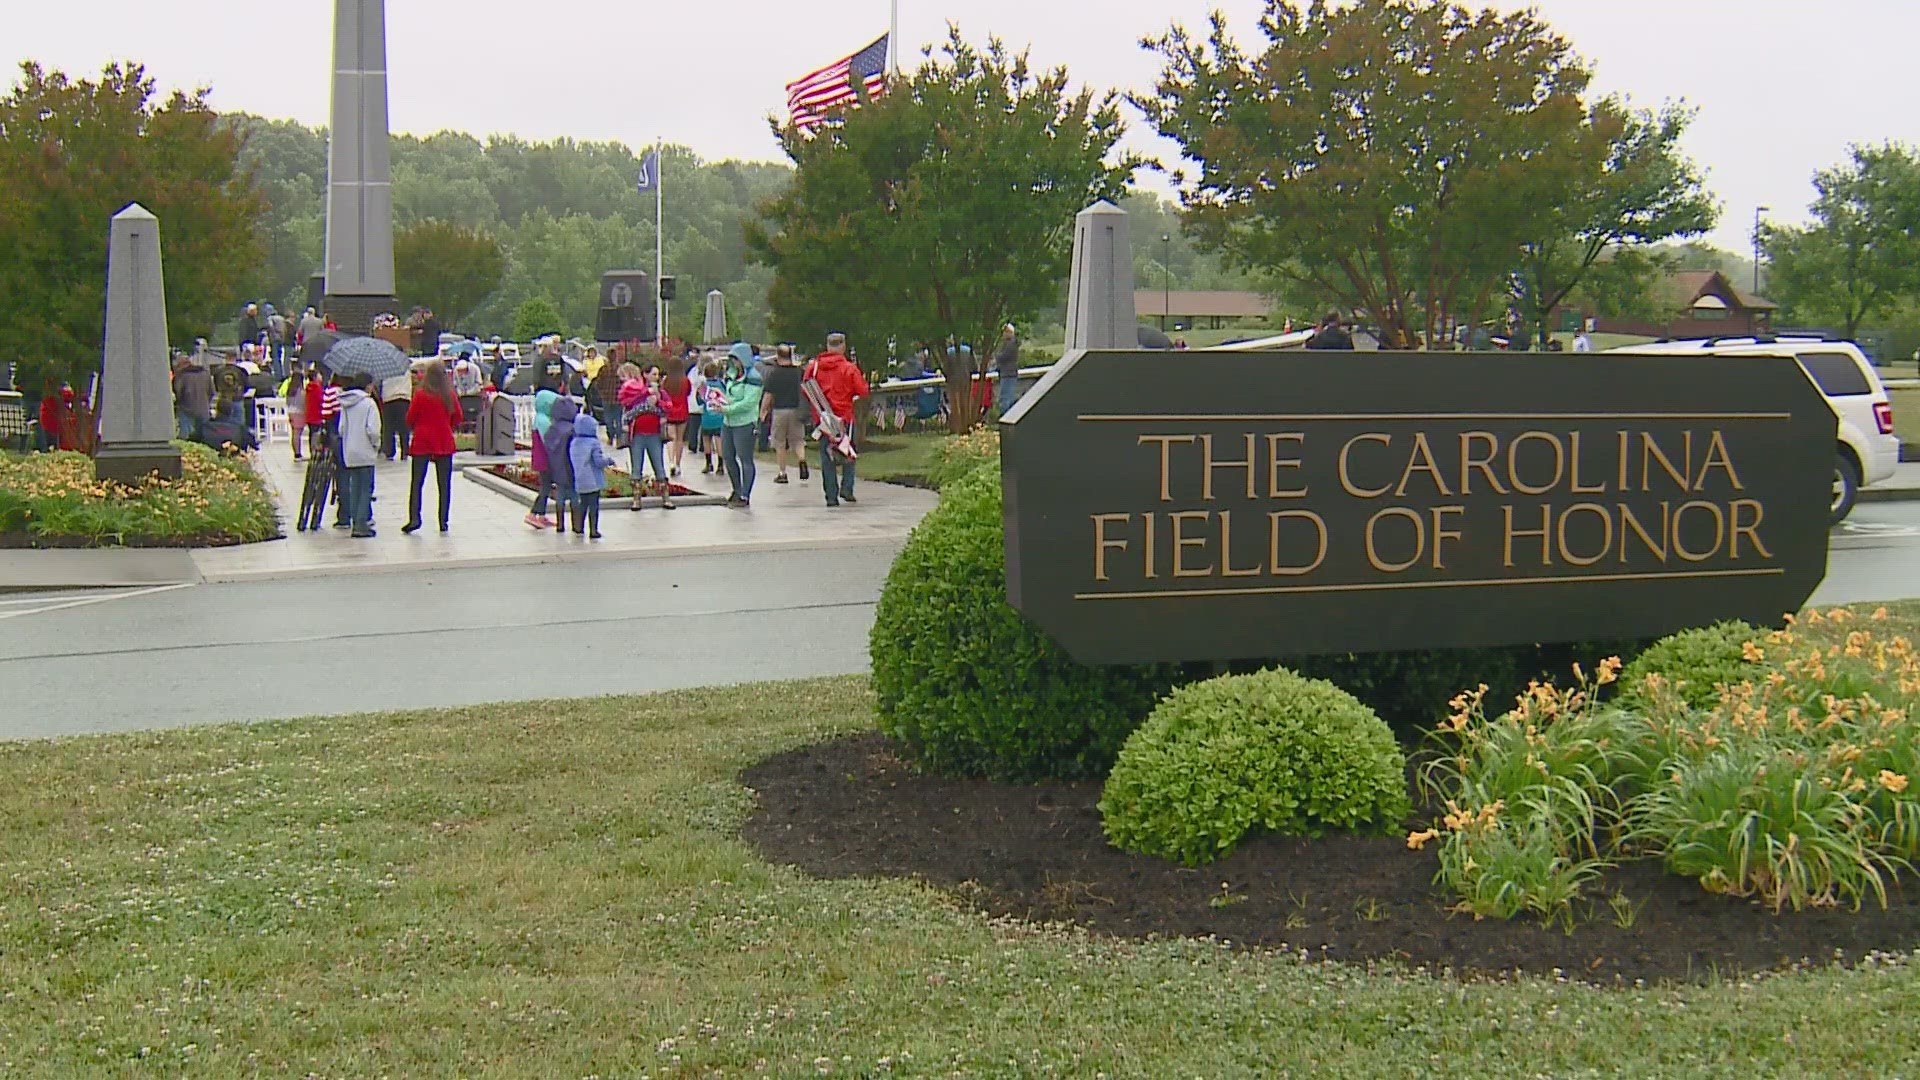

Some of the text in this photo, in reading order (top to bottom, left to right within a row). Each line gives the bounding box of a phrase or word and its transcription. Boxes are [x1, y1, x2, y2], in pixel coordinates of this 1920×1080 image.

[1136, 429, 1746, 501] THE CAROLINA
[1089, 498, 1773, 580] FIELD OF HONOR
